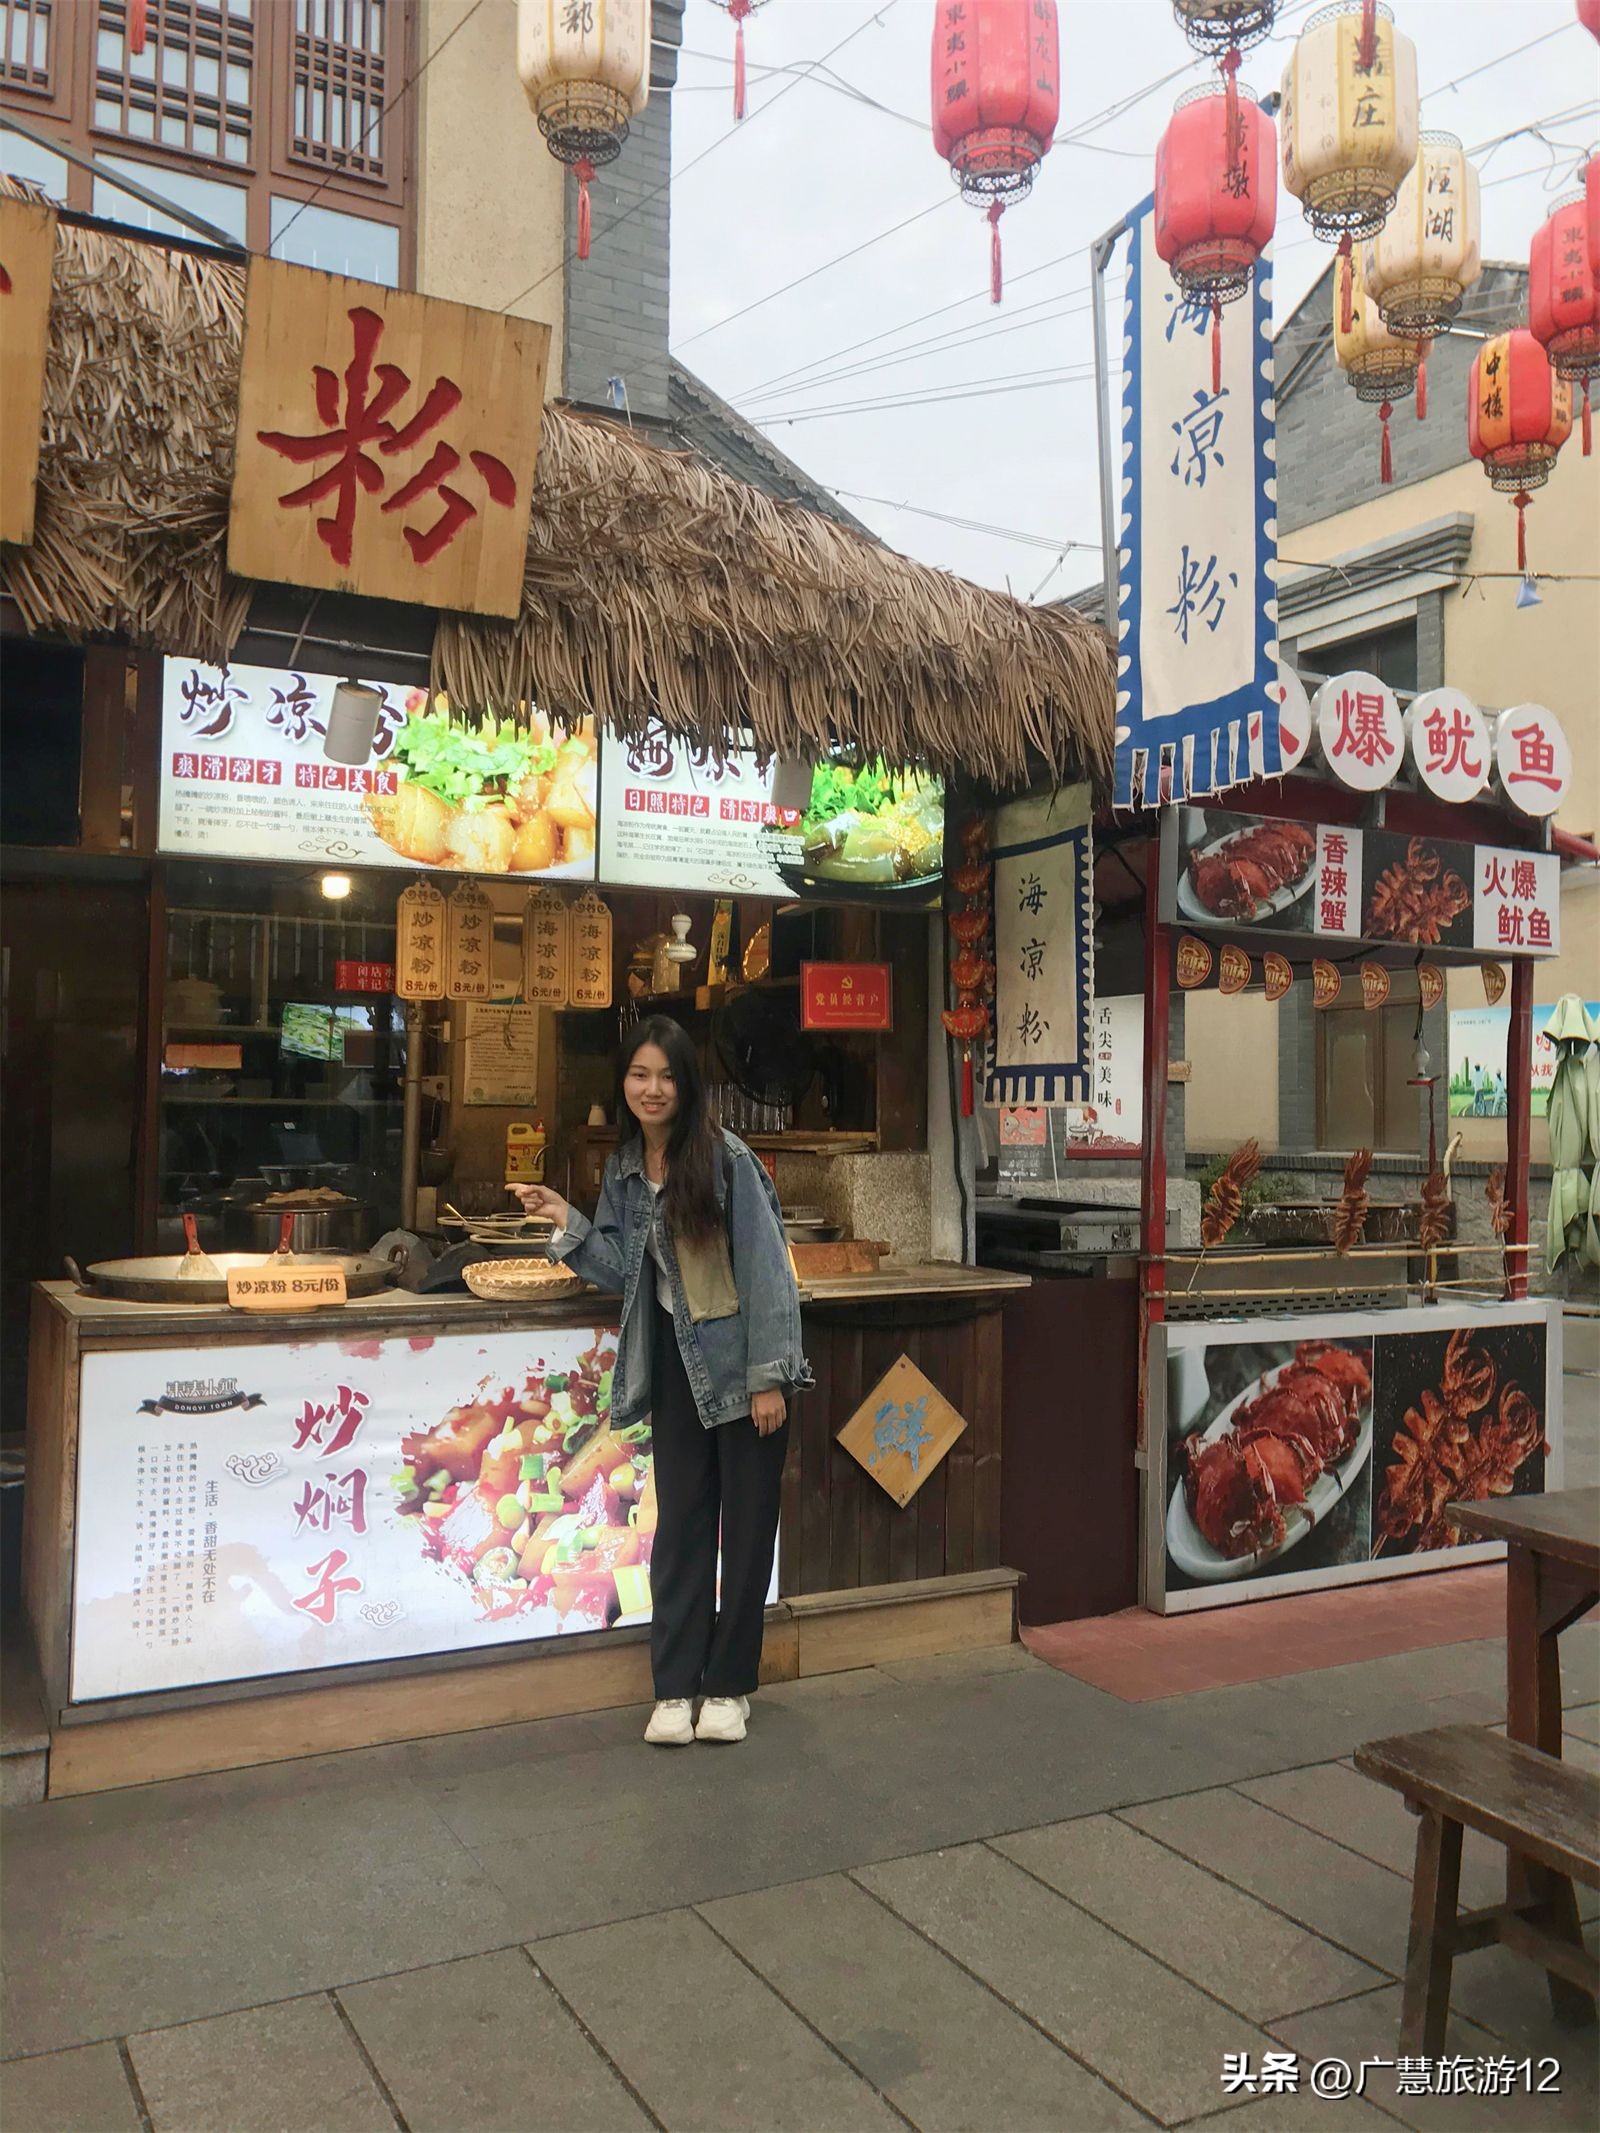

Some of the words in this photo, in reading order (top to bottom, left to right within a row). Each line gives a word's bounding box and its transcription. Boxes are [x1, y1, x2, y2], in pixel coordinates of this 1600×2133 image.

[257, 306, 518, 567] 粉
[174, 753, 281, 784] 爽滑弹牙
[297, 765, 397, 796] 特色美食
[627, 789, 709, 818] 日照特色
[721, 799, 800, 828] 清凉爽口
[1319, 833, 1349, 932] 香辣蟹
[1483, 857, 1537, 901] 火爆
[410, 911, 435, 975] 炒凉粉
[458, 912, 482, 976] 炒凉粉
[1497, 903, 1552, 948] 鱿鱼
[535, 920, 559, 981] 海凉粉
[579, 923, 601, 983] 海凉粉
[1018, 873, 1050, 1046] 海凉粉
[405, 979, 438, 993] 8元/份
[453, 981, 486, 994] 8元/份
[531, 985, 562, 998] 6元/份
[576, 988, 606, 1001] 6元/份
[236, 1279, 287, 1294] 炒凉粉
[292, 1279, 340, 1294] 8元/份
[210, 1401, 234, 1410] TOWN
[292, 1384, 370, 1625] 炒焖子
